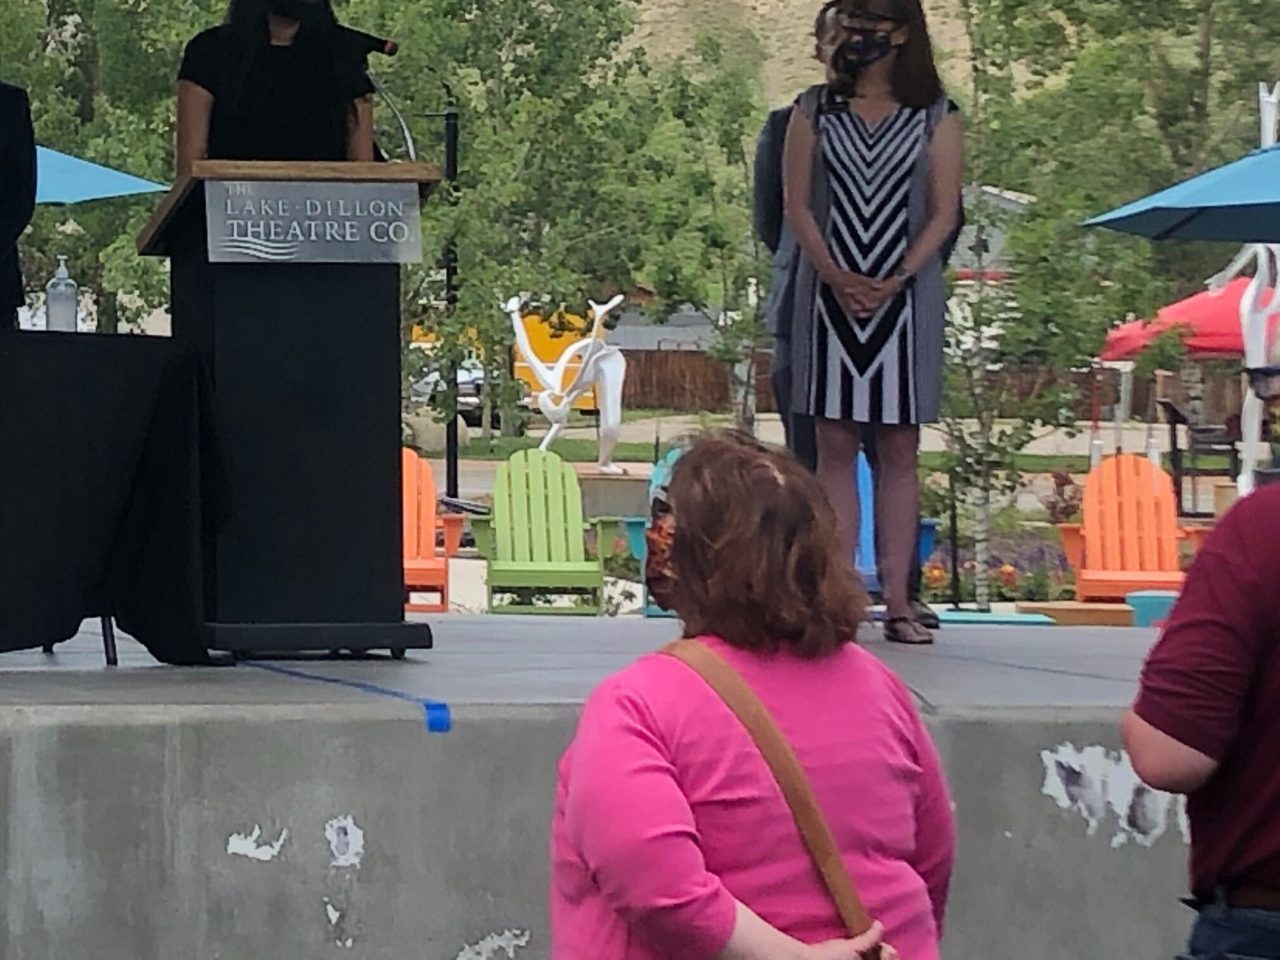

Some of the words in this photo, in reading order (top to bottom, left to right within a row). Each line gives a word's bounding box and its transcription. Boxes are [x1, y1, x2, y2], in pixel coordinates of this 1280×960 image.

[226, 199, 290, 217] LAKE
[305, 199, 404, 217] DILLON
[226, 219, 360, 242] THEATRE
